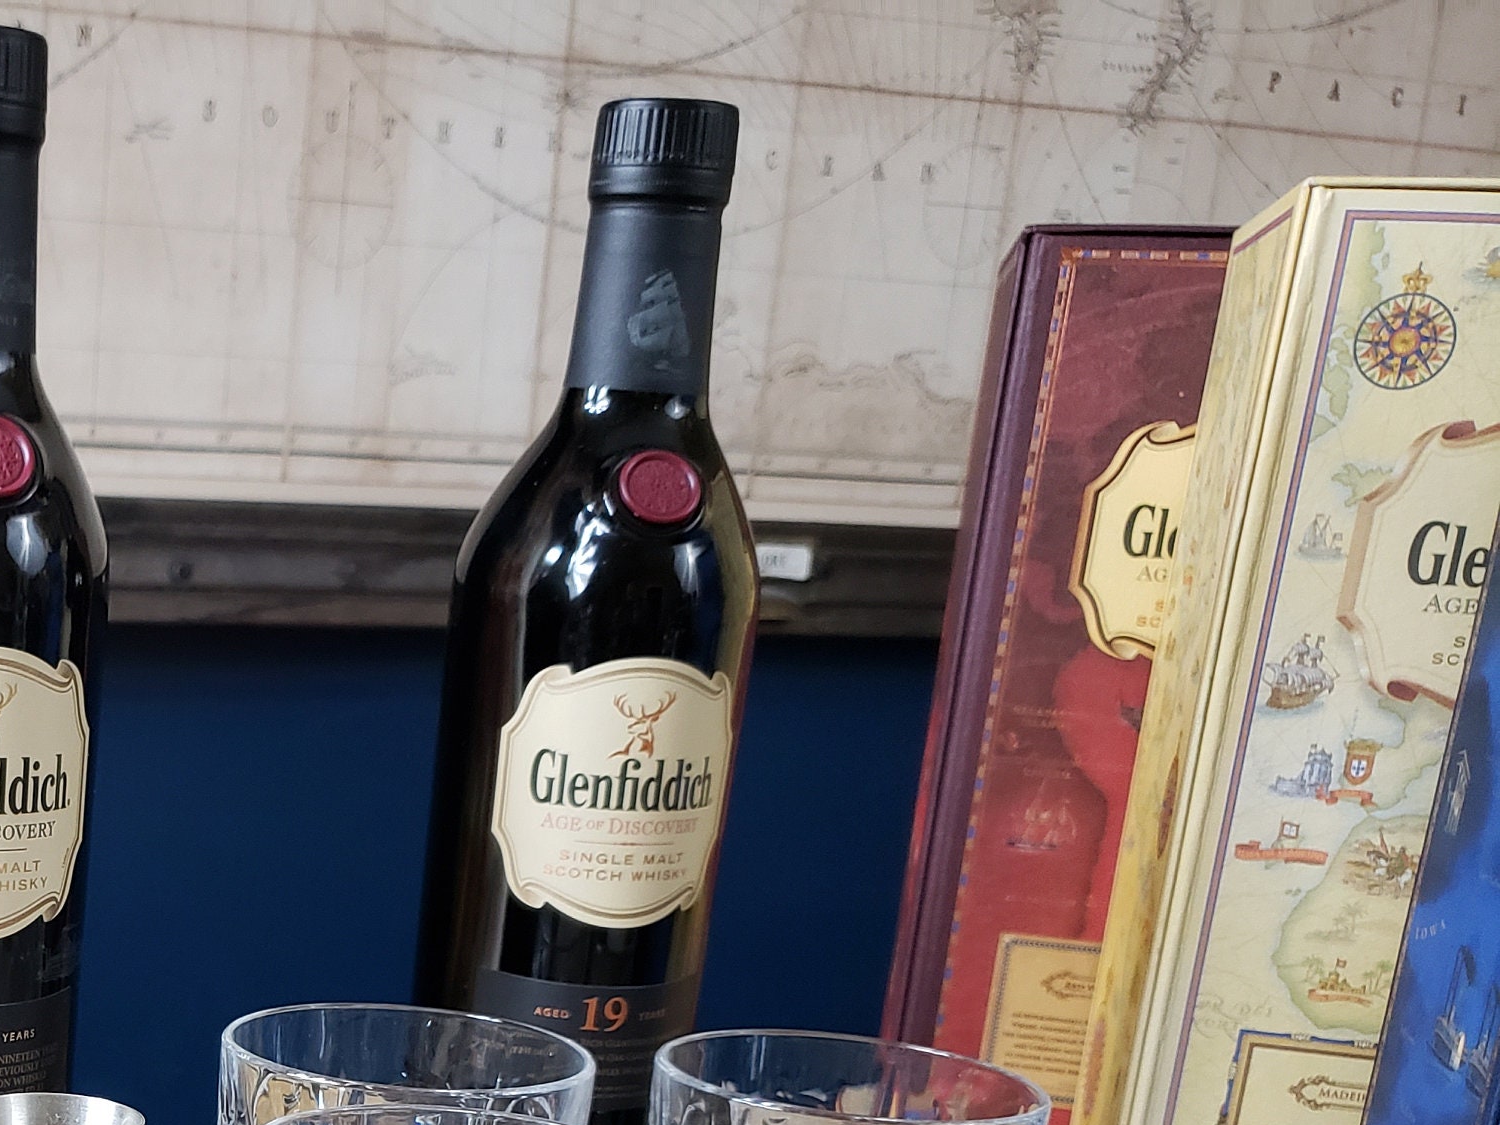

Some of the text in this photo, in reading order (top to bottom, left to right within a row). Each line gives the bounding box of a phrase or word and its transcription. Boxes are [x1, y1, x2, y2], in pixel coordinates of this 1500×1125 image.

[1422, 593, 1480, 615] AGE
[530, 748, 712, 812] Glenfiddich
[540, 812, 699, 836] AGE OF DISCOVERY
[559, 849, 685, 866] SINGLE MALT
[542, 863, 687, 882] SCOTCH WHISKY
[534, 1006, 570, 1020] AGED
[579, 996, 629, 1032] 19
[2, 1029, 35, 1043] YEARS
